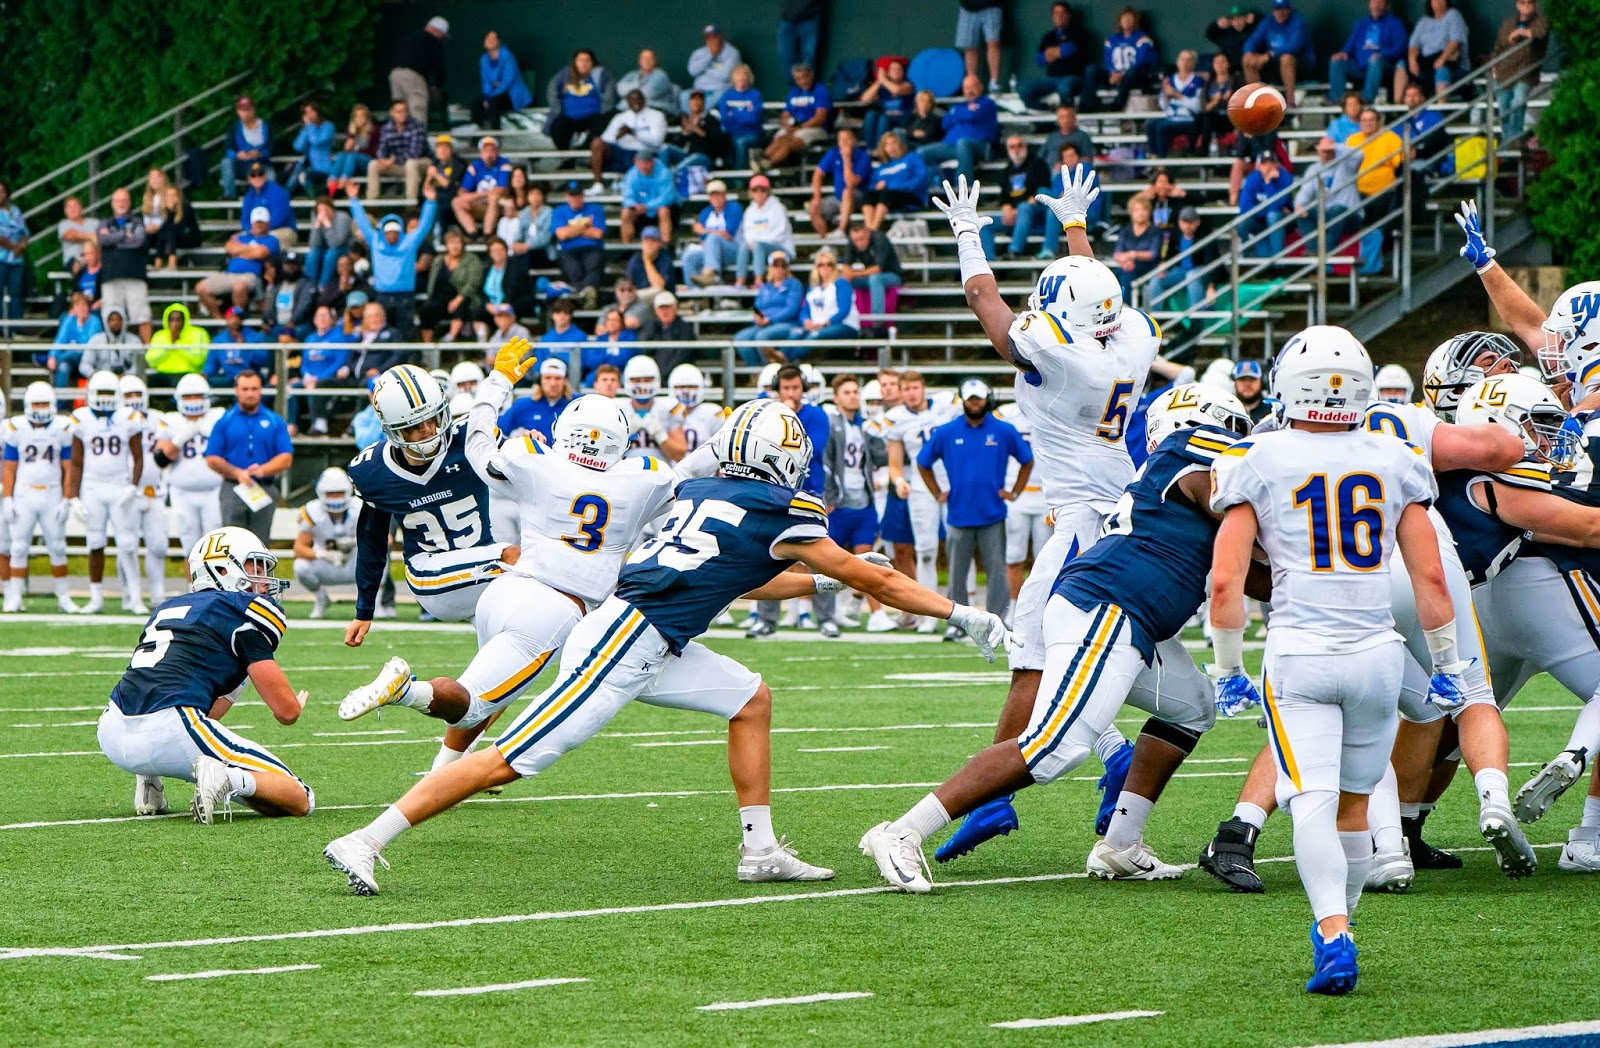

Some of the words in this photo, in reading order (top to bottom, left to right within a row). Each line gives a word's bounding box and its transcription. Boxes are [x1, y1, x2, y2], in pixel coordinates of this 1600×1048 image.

[1473, 379, 1507, 410] L
[1095, 380, 1136, 444] 5
[1307, 410, 1358, 422] Riddell
[24, 444, 55, 463] 24
[568, 452, 607, 469] Riddell
[724, 462, 751, 474] schutt
[408, 489, 453, 509] WARRIORS
[402, 494, 483, 552] 35
[561, 491, 612, 555] 3
[1292, 471, 1386, 573] 16
[204, 532, 230, 561] L
[130, 605, 193, 670] 5
